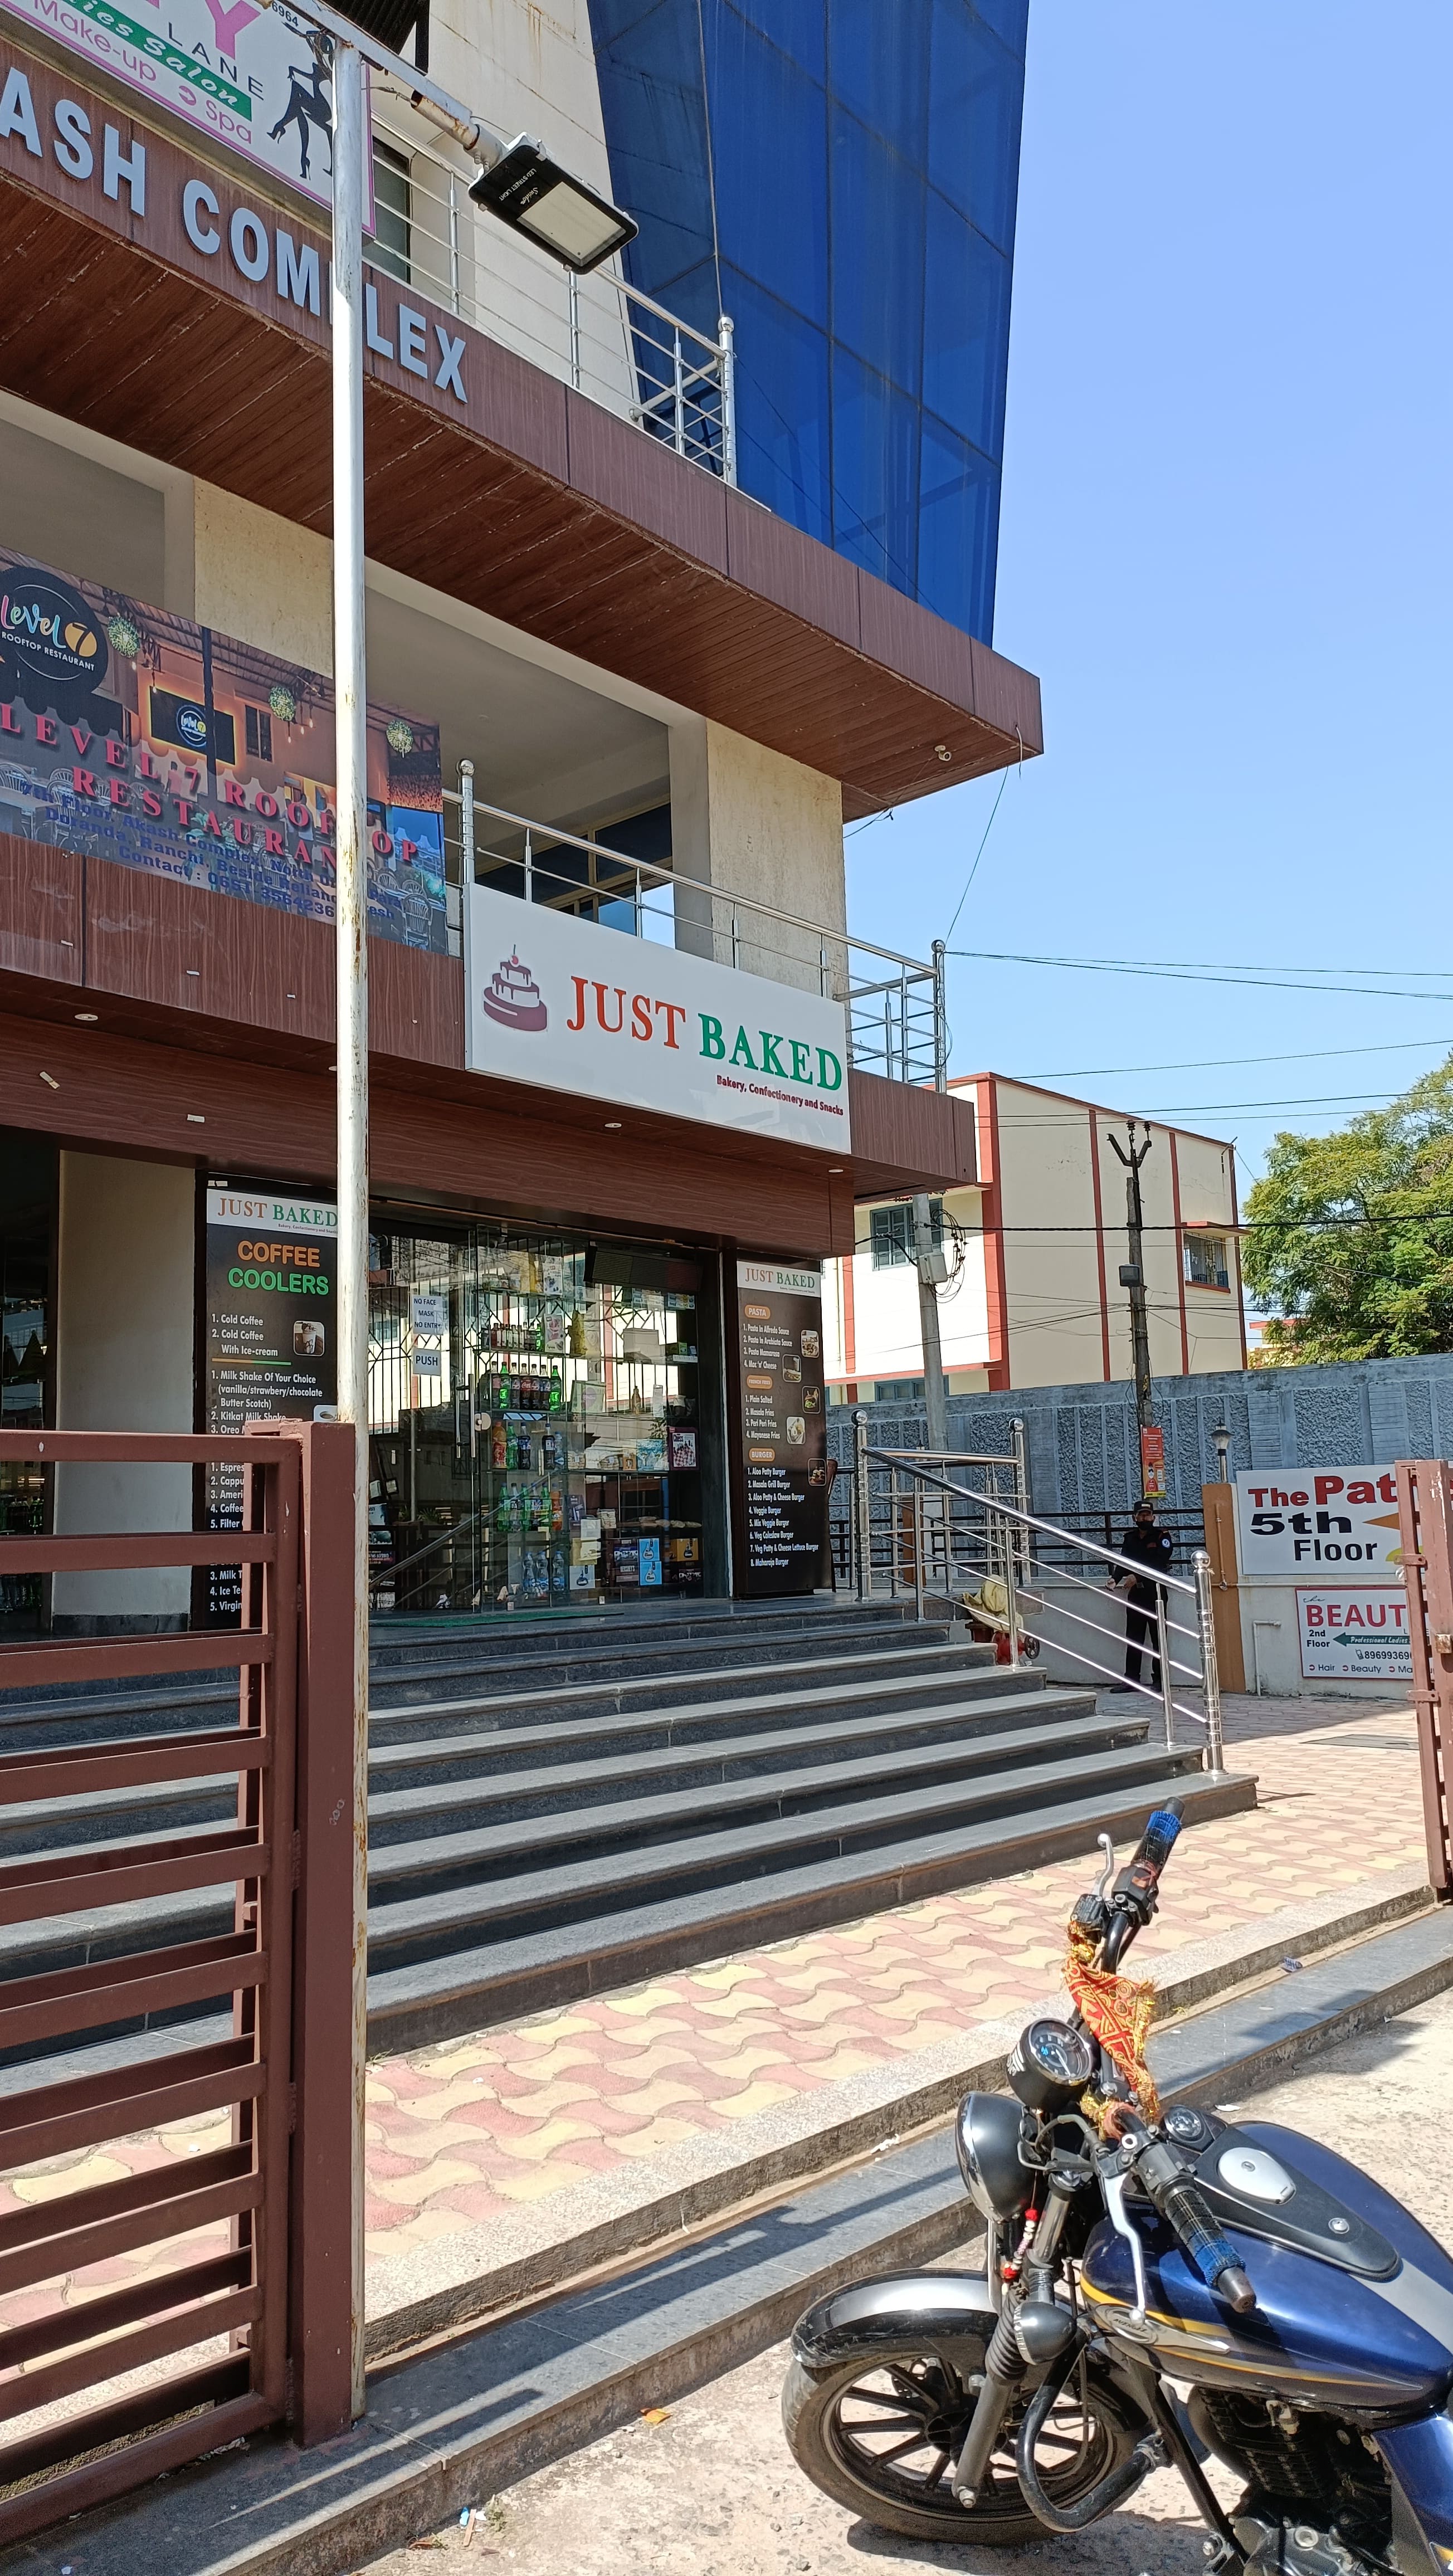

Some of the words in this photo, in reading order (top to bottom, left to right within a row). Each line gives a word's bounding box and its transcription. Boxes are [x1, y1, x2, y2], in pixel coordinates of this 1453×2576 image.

[34, 0, 157, 81] Make-up
[169, 22, 264, 101] LANE
[143, 37, 238, 107] Salon
[206, 100, 251, 144] Spa
[511, 175, 528, 191] STREET
[0, 66, 146, 217] ASH
[183, 179, 468, 403] COMLEX
[70, 622, 93, 656] 7
[2, 632, 42, 651] ROOFTOP
[44, 647, 95, 671] RESTAURANT
[1, 704, 158, 779] LEVEL
[184, 766, 198, 790] 7
[224, 781, 417, 862] ROOFOP
[72, 766, 337, 869] RESTAURAN
[123, 815, 179, 842] Akash
[271, 858, 314, 882] North
[119, 845, 191, 877] Contact
[217, 858, 273, 885] Beside
[367, 904, 394, 919] esh
[566, 975, 686, 1050] JUST
[698, 1012, 842, 1091] BAKED
[716, 1075, 747, 1093] Bakery,
[749, 1083, 803, 1108] Confectionery
[804, 1099, 818, 1109] and
[820, 1101, 843, 1116] Snacks
[217, 1198, 267, 1218] JUST
[272, 1204, 338, 1227] BAKED
[237, 1240, 320, 1267] COFFEE
[228, 1267, 329, 1295] COOLERS
[745, 1268, 773, 1283] JUST
[777, 1272, 815, 1288] BAKED
[748, 1307, 767, 1316] PASTA
[212, 1314, 219, 1323] 1.
[221, 1314, 238, 1324] Cold
[240, 1316, 264, 1326] Coffee
[212, 1329, 219, 1338] 2.
[221, 1329, 238, 1339] Cold
[240, 1330, 264, 1341] Coffee
[221, 1344, 239, 1354] With
[241, 1345, 278, 1357] Ice-cream
[416, 1356, 438, 1367] PUSH
[211, 1370, 218, 1379] 1.
[220, 1370, 237, 1380] Milk
[239, 1371, 262, 1381] Shake
[264, 1372, 274, 1382] Of
[275, 1373, 291, 1383] Your
[293, 1374, 316, 1384] Choice
[221, 1398, 244, 1408] Butter
[246, 1399, 272, 1410] Scotch)
[211, 1411, 218, 1420] 2.
[221, 1411, 243, 1421] Kitkat
[246, 1412, 261, 1421] Milk
[211, 1424, 218, 1434] 3.
[220, 1425, 240, 1435] Oreo
[211, 1462, 218, 1472] 1.
[220, 1462, 245, 1474] Espres
[772, 1467, 786, 1477] Burger
[211, 1476, 218, 1485] 2.
[777, 1480, 791, 1490] Burger
[211, 1490, 218, 1499] 3.
[1247, 1487, 1309, 1507] The
[1314, 1473, 1398, 1505] Pat
[210, 1504, 218, 1513] 4.
[220, 1503, 244, 1513] Coffee
[753, 1506, 767, 1516] Veggie
[768, 1506, 781, 1515] Burger
[210, 1519, 218, 1529] 5.
[220, 1518, 240, 1528] Filter
[776, 1518, 789, 1528] Burger
[1250, 1511, 1352, 1536] 5th
[1294, 1539, 1378, 1562] Floor
[210, 1571, 217, 1580] 3.
[220, 1570, 236, 1580] Milk
[209, 1587, 217, 1596] 4.
[220, 1586, 231, 1596] Ice
[209, 1602, 217, 1612] 5.
[1306, 1604, 1406, 1627] BEAUT
[1309, 1629, 1326, 1637] 2nd
[1364, 1651, 1412, 1660] 89699369
[1351, 1665, 1382, 1674] Beauty
